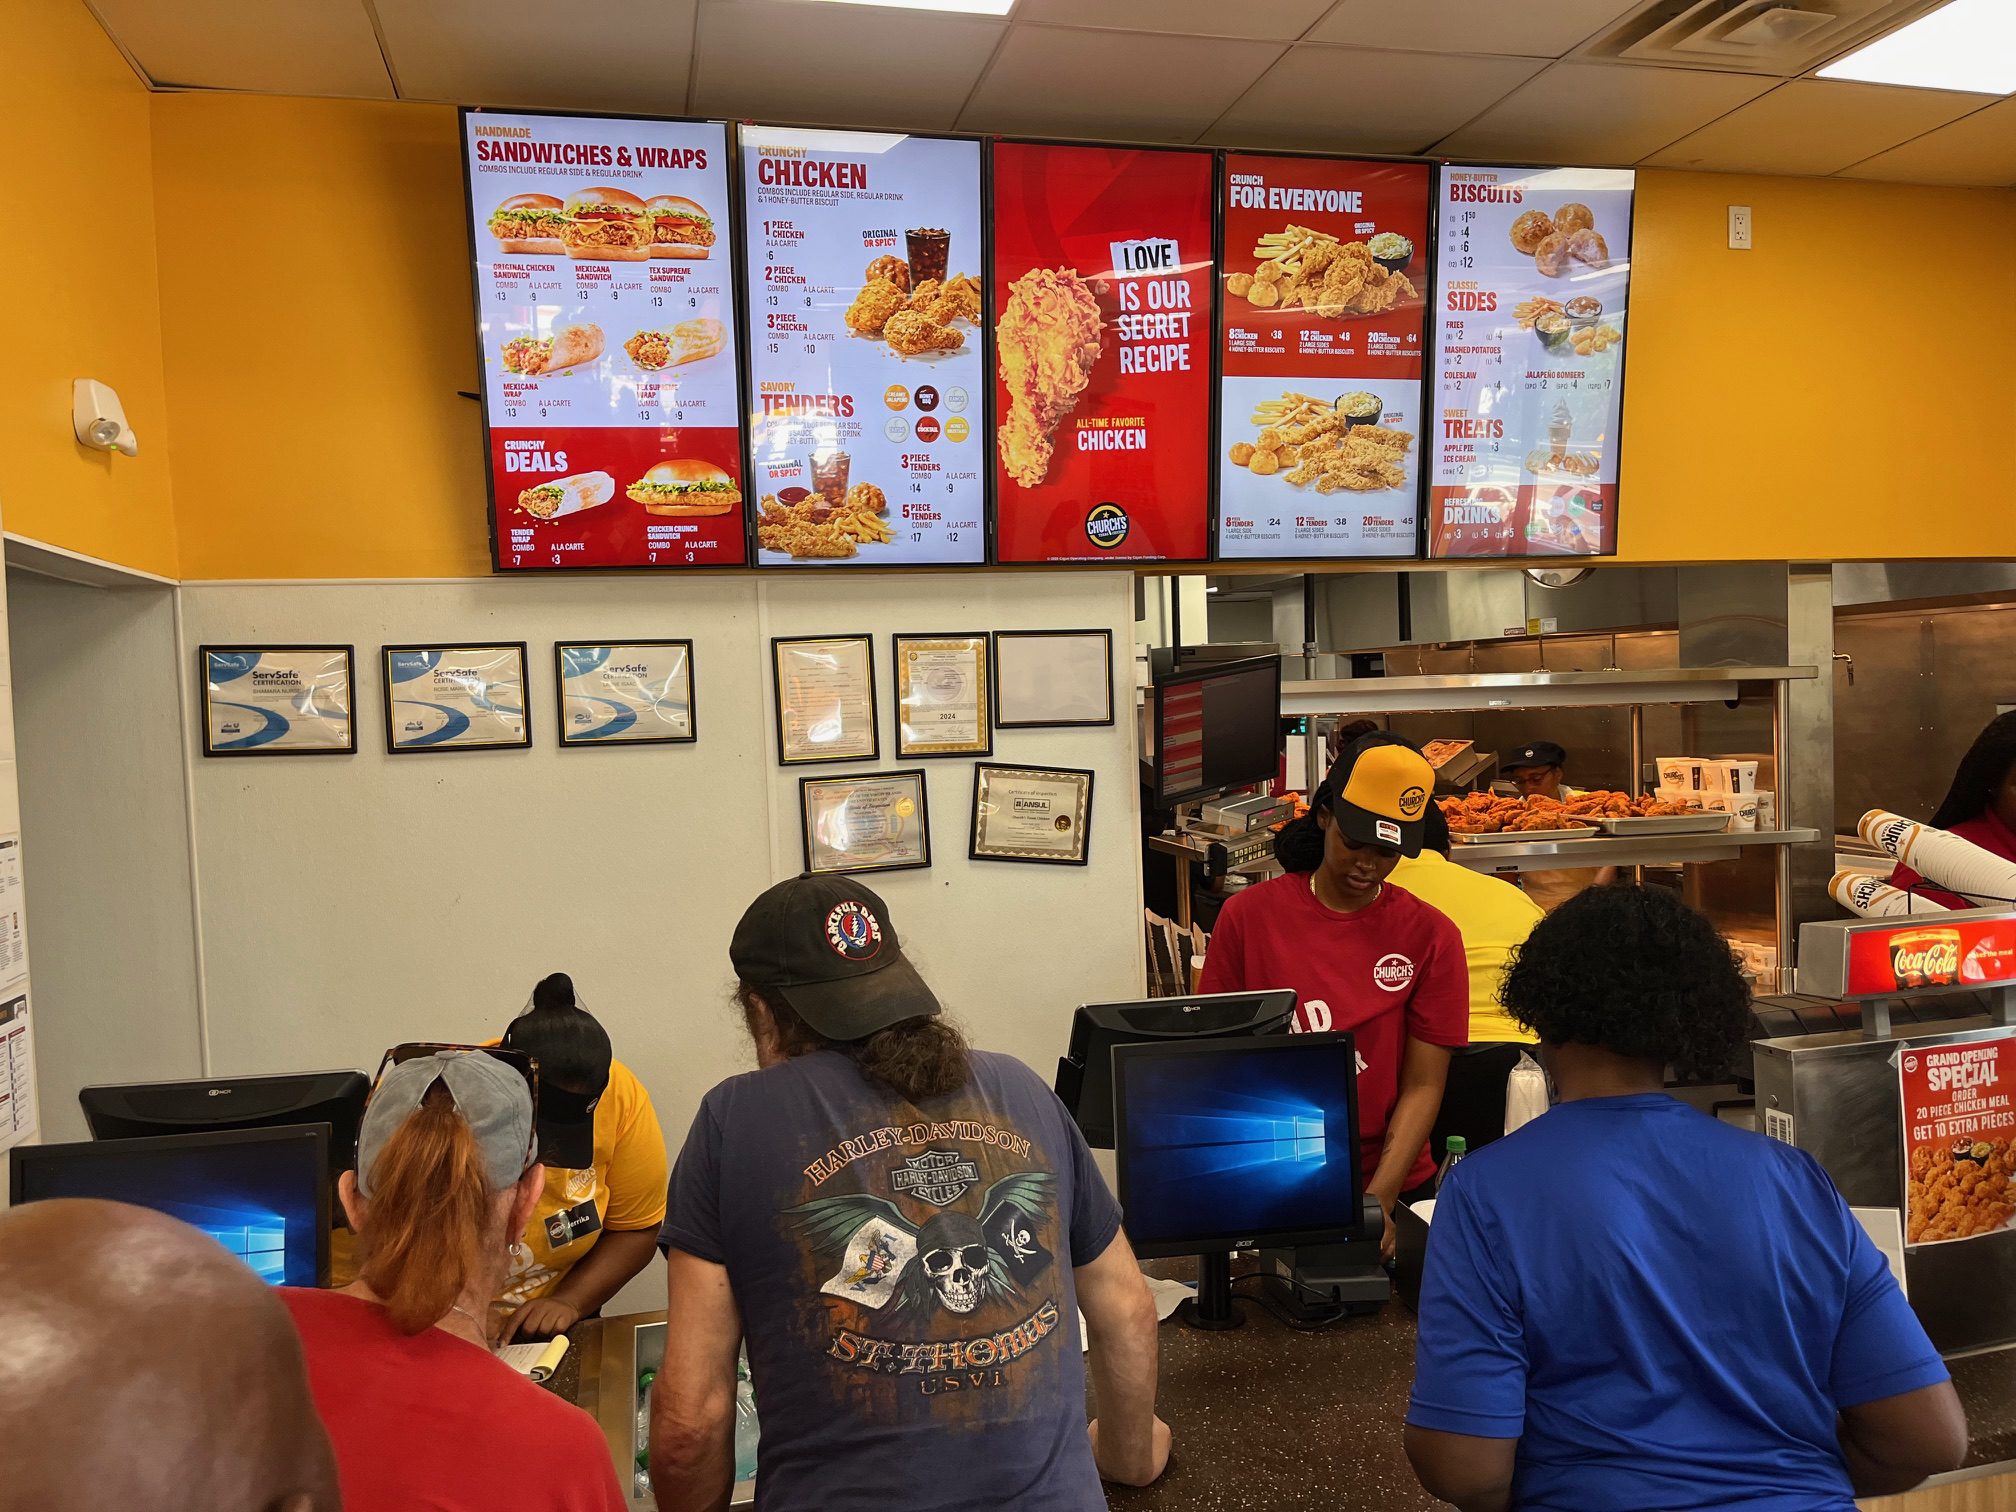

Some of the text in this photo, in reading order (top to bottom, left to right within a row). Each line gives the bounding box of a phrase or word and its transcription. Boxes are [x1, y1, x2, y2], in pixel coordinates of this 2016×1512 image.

[475, 126, 531, 138] HANDMADE
[477, 141, 707, 169] SANDWICHES & WRAPS
[758, 145, 807, 158] CRUNCHY
[479, 165, 643, 178] COMBOS INCLUDE REGULAR SIDE & REGULAR DRINK
[759, 159, 867, 189] CHICKEN
[1450, 173, 1498, 182] HONEY-BUTTER
[1230, 174, 1263, 185] CRUNCH
[1230, 186, 1362, 213] FOR EVERYONE
[1450, 184, 1522, 203] BISCUITS
[763, 221, 793, 235] 1 PIECE
[773, 231, 804, 239] CHICKEN
[862, 229, 898, 238] ORIGINAL
[864, 238, 896, 247] OR SPICY
[1123, 243, 1172, 273] LOVE
[526, 264, 555, 272] CHICKEN
[576, 265, 610, 273] MEXICANA
[765, 267, 772, 280] 2
[774, 276, 806, 284] CHICKEN
[1448, 281, 1478, 290] CLASSIC
[1119, 281, 1191, 310] IS OUR
[1447, 292, 1497, 311] SIDES
[768, 314, 796, 328] 3 PIECE
[776, 323, 808, 331] CHICKEN
[1118, 312, 1190, 341] SECRET
[1229, 329, 1234, 339] 8
[1300, 331, 1309, 340] 12
[1368, 333, 1378, 342] 20
[1445, 346, 1501, 354] MASHED POTATOES
[1120, 344, 1190, 373] RECIPE
[1525, 370, 1556, 379] JALAPEÑO
[760, 382, 795, 392] SAVORY
[761, 394, 854, 417] TENDERS
[1444, 409, 1467, 417] SWEET
[1076, 417, 1145, 428] ALL-TIME FAVORITE
[1443, 420, 1503, 438] TREATS
[505, 441, 545, 450] CRUNCHY
[1077, 429, 1146, 450] CHICKEN
[505, 451, 568, 472] DEALS
[901, 454, 930, 468] 3 PIECE
[910, 463, 940, 471] TENDERS
[769, 468, 802, 478] OR SPICY
[902, 504, 909, 518] 5
[1444, 507, 1500, 524] DRINKS
[1087, 517, 1127, 535] CHURCH'S
[1226, 517, 1232, 526] 8
[1296, 517, 1304, 526] 12
[1363, 516, 1373, 525] 20
[253, 670, 299, 678] ServSafe
[434, 669, 477, 677] ServSafe
[603, 664, 647, 672] ervSafe
[1399, 793, 1425, 808] CHURCH'S
[828, 902, 881, 955] GRATEFUL DEAD
[1895, 944, 1957, 977] Coca-Cola
[1374, 965, 1413, 981] CHURCH'S
[1927, 1053, 1959, 1067] GRAND
[1961, 1047, 1998, 1064] OPENING
[1927, 1061, 1998, 1091] SPECIAL
[1952, 1088, 1977, 1102] ORDER
[1917, 1095, 2010, 1119] 20 PIECE CHICKEN MEAL
[1914, 1112, 2014, 1140] GET 10 EXTRA PIECES
[804, 1121, 1030, 1186] HARLEY-DAVIDSON
[911, 1154, 954, 1168] MOTOR
[896, 1164, 975, 1186] HARLEY-DAVIDSON
[918, 1185, 960, 1199] CYCLES
